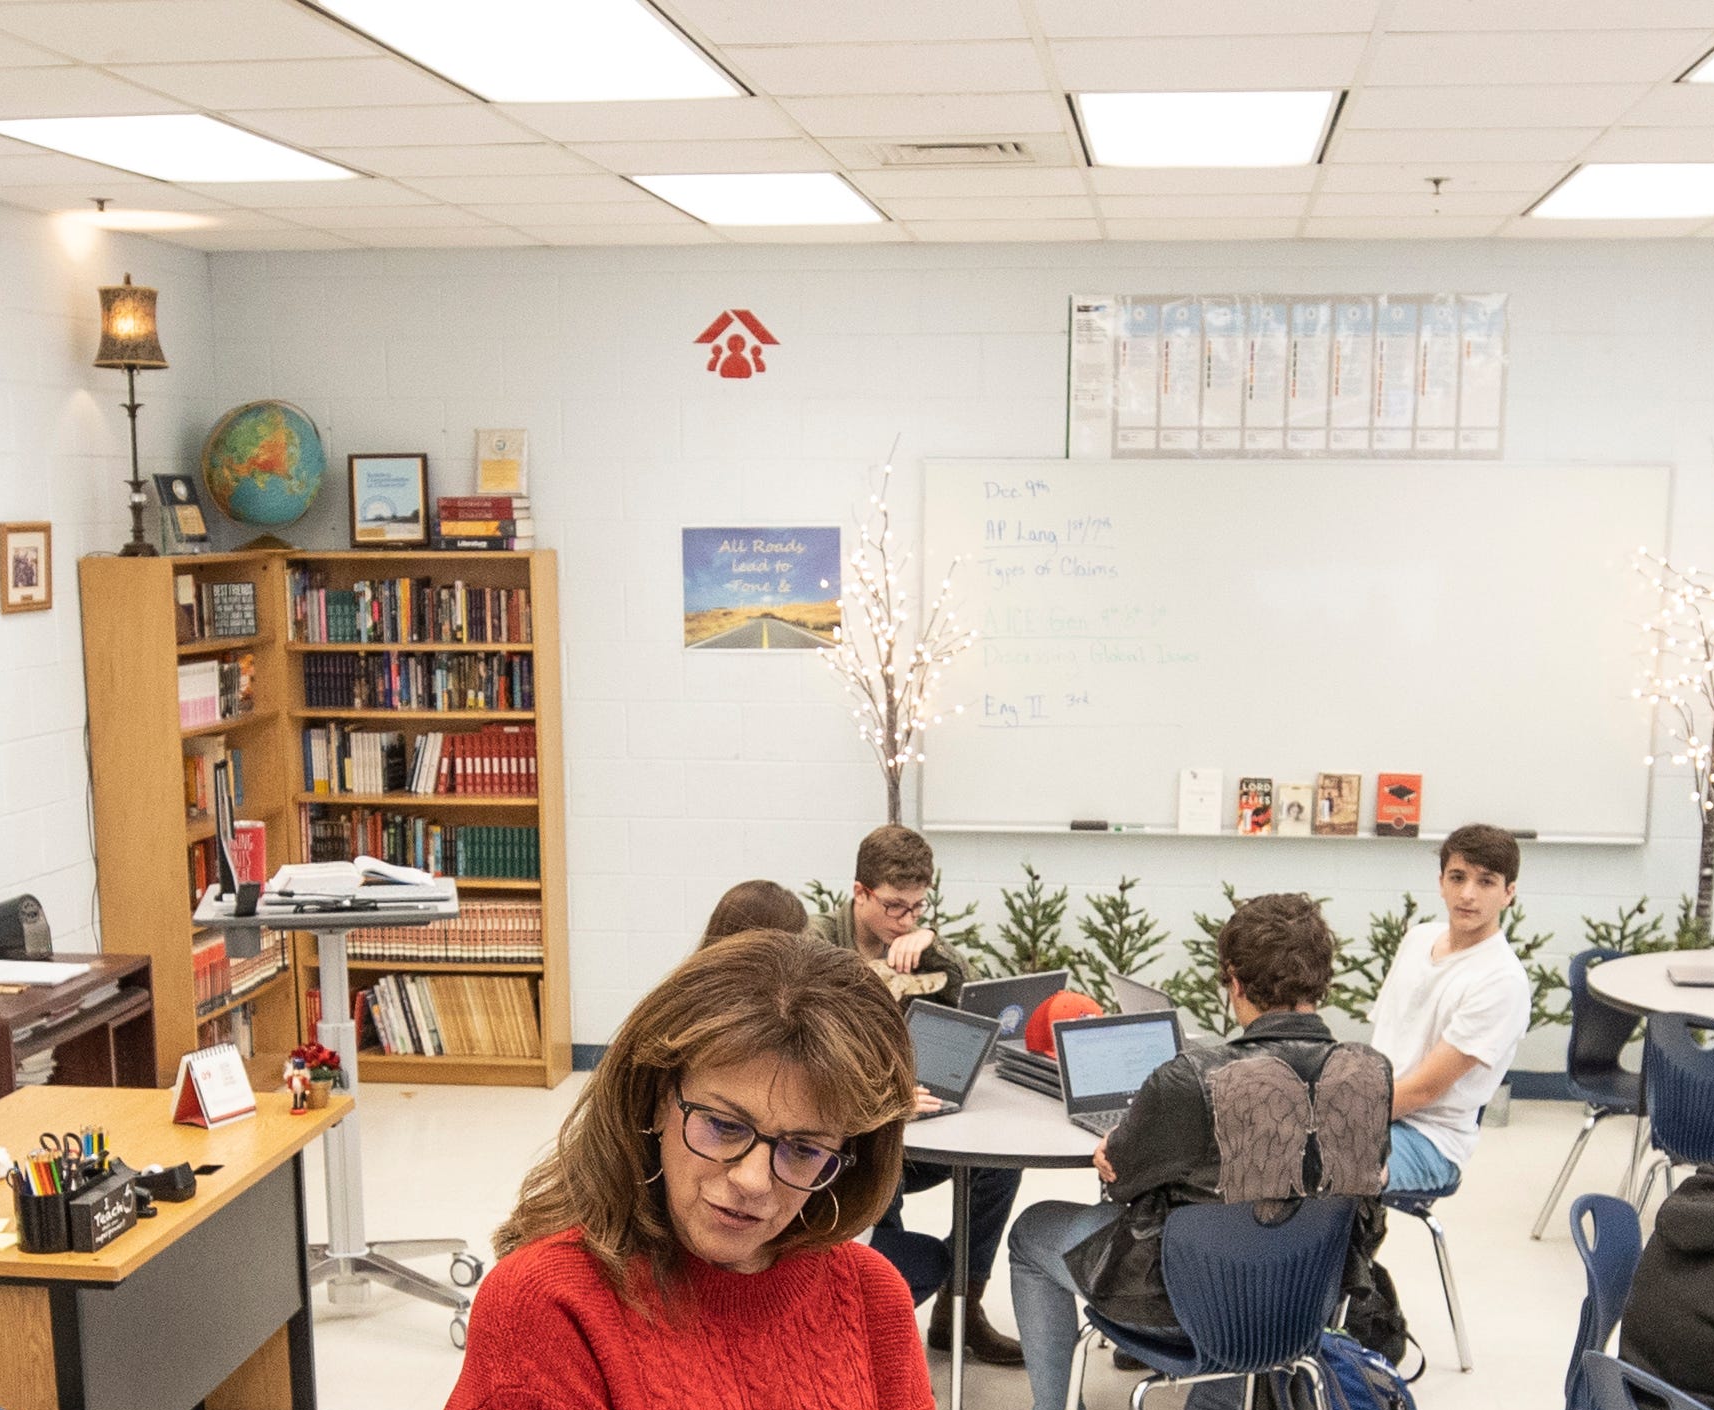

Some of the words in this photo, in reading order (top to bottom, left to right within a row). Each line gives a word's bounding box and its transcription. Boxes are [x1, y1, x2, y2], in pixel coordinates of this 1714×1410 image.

[719, 539, 747, 553] All
[752, 539, 807, 553] Roads
[985, 519, 1006, 541] AP
[1017, 519, 1058, 556] Lang
[977, 558, 1026, 591] Types
[1035, 559, 1052, 576] of
[1060, 555, 1119, 578] Claims
[984, 693, 1020, 727] Eng
[1065, 690, 1090, 707] 3rd
[1241, 795, 1271, 805] FLIES
[1242, 782, 1271, 792] LORD
[94, 1201, 124, 1227] Teach
